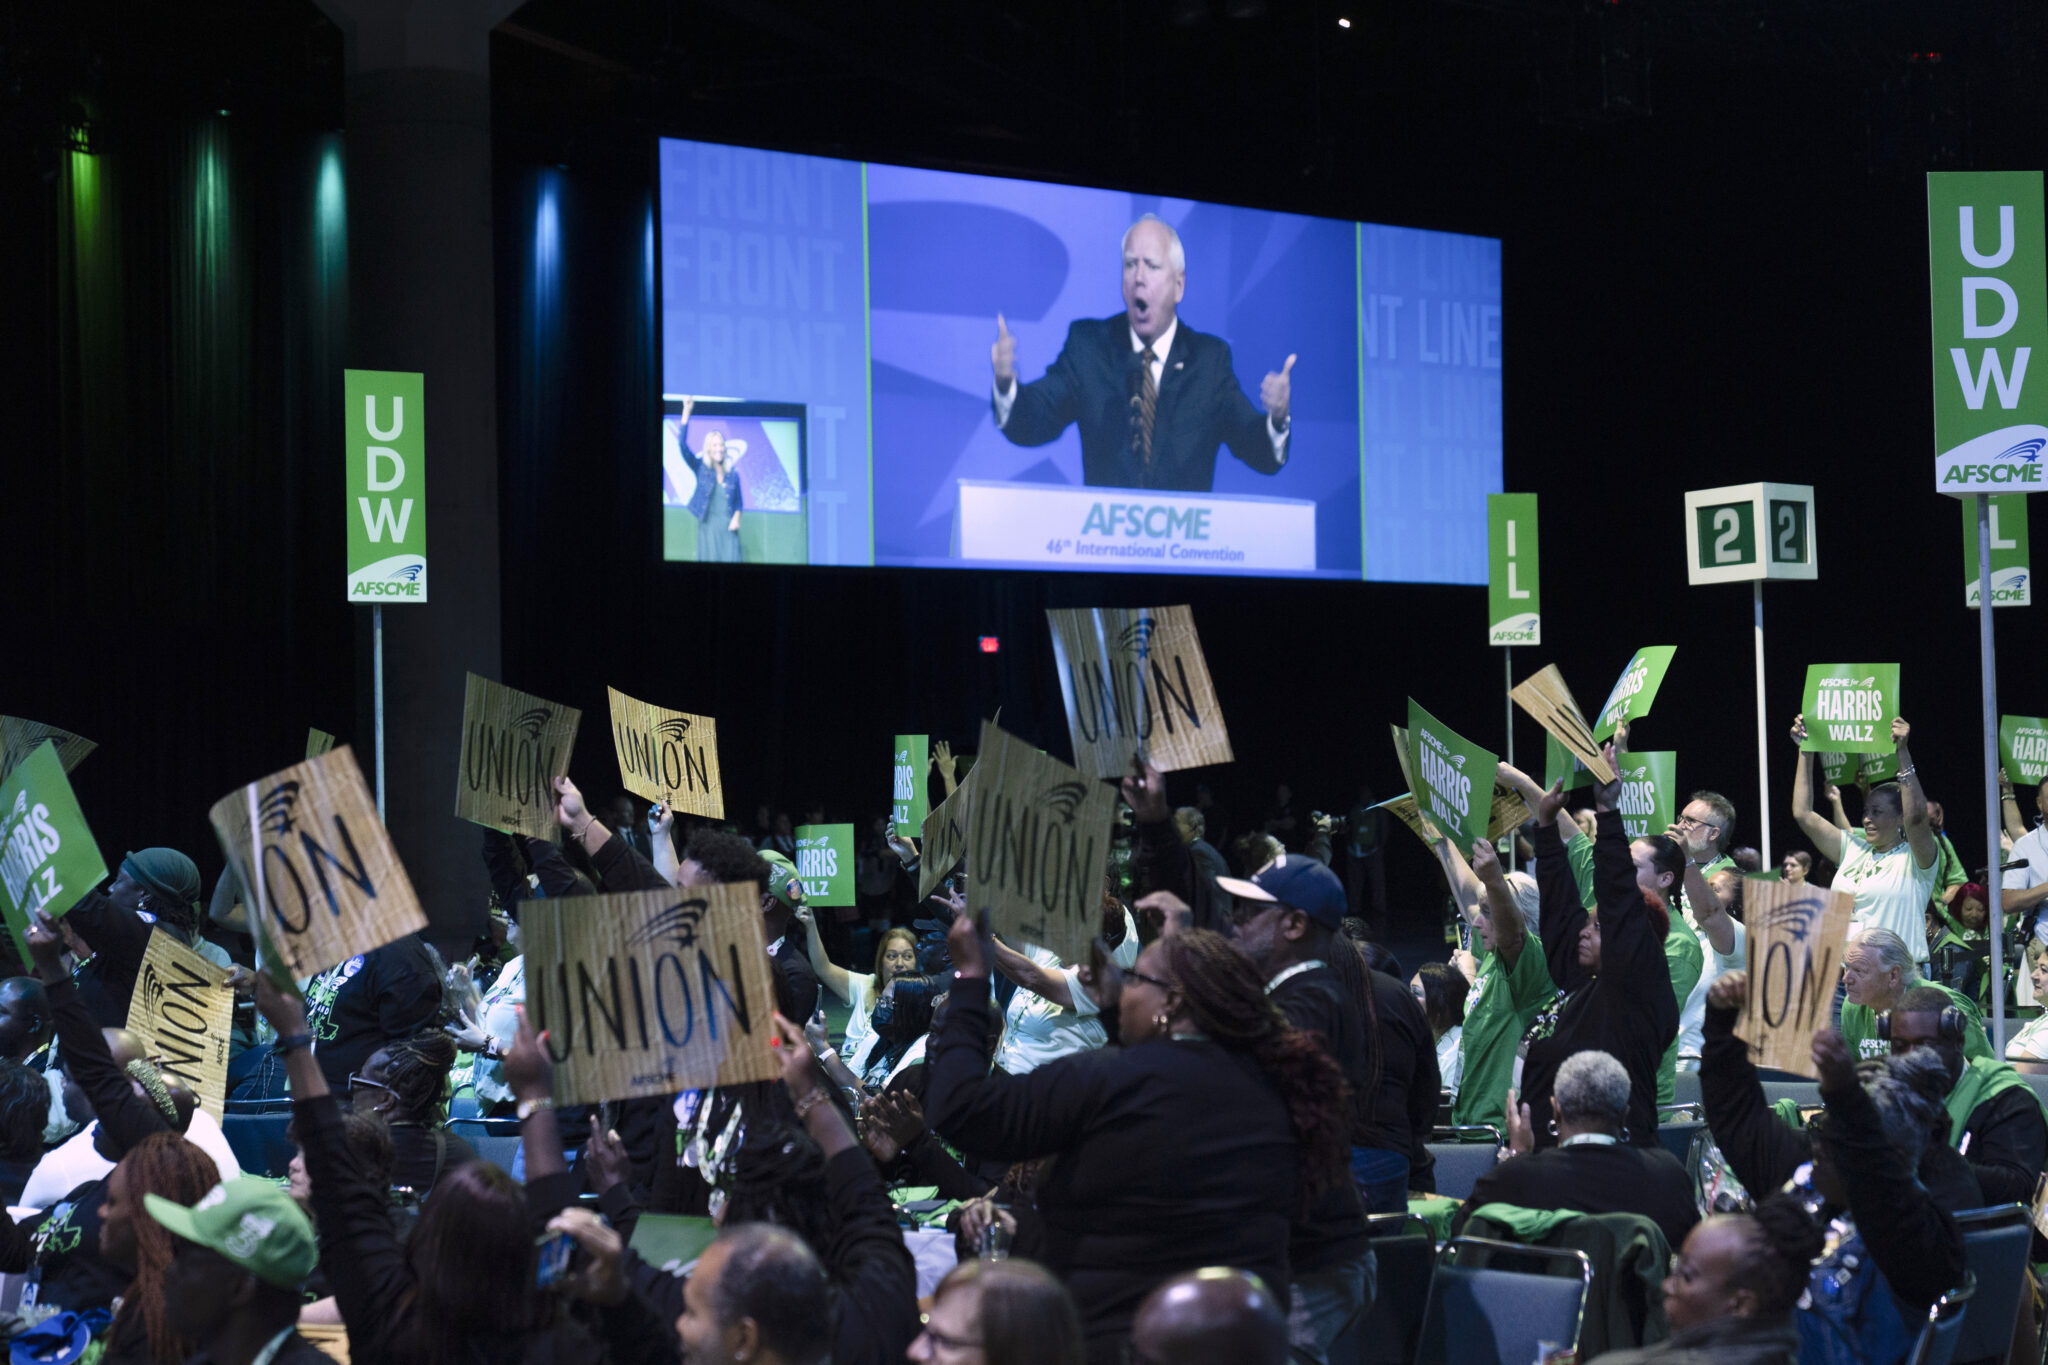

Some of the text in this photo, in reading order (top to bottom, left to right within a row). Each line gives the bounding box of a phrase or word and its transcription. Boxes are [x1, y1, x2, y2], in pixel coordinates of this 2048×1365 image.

[667, 226, 844, 312] FRONT
[1419, 298, 1501, 369] LINE
[1950, 205, 2031, 410] UDW
[669, 310, 846, 397] FRONT
[358, 395, 414, 543] UDW
[1942, 463, 2043, 484] AFSCME
[1081, 502, 1212, 540] AFSCME
[1713, 507, 1742, 564] 2
[1778, 505, 1797, 560] 2
[1989, 496, 2016, 549] L
[1046, 539, 1245, 561] 46th International Convention
[352, 581, 420, 596] AFSCME
[1970, 589, 2025, 601] ASCME
[1493, 631, 1536, 641] AFSCME
[1817, 690, 1882, 721] HARRIS
[1819, 678, 1850, 687] AFSCME
[618, 722, 710, 794] UNION
[1828, 724, 1873, 741] WALZ
[467, 720, 556, 811] UNION
[1420, 741, 1471, 817] HARRIS
[1430, 791, 1463, 837] WALZ
[977, 789, 1093, 923] UNION
[803, 881, 829, 896] ALZ
[537, 944, 751, 1063] UNION
[153, 961, 211, 1108] NION
